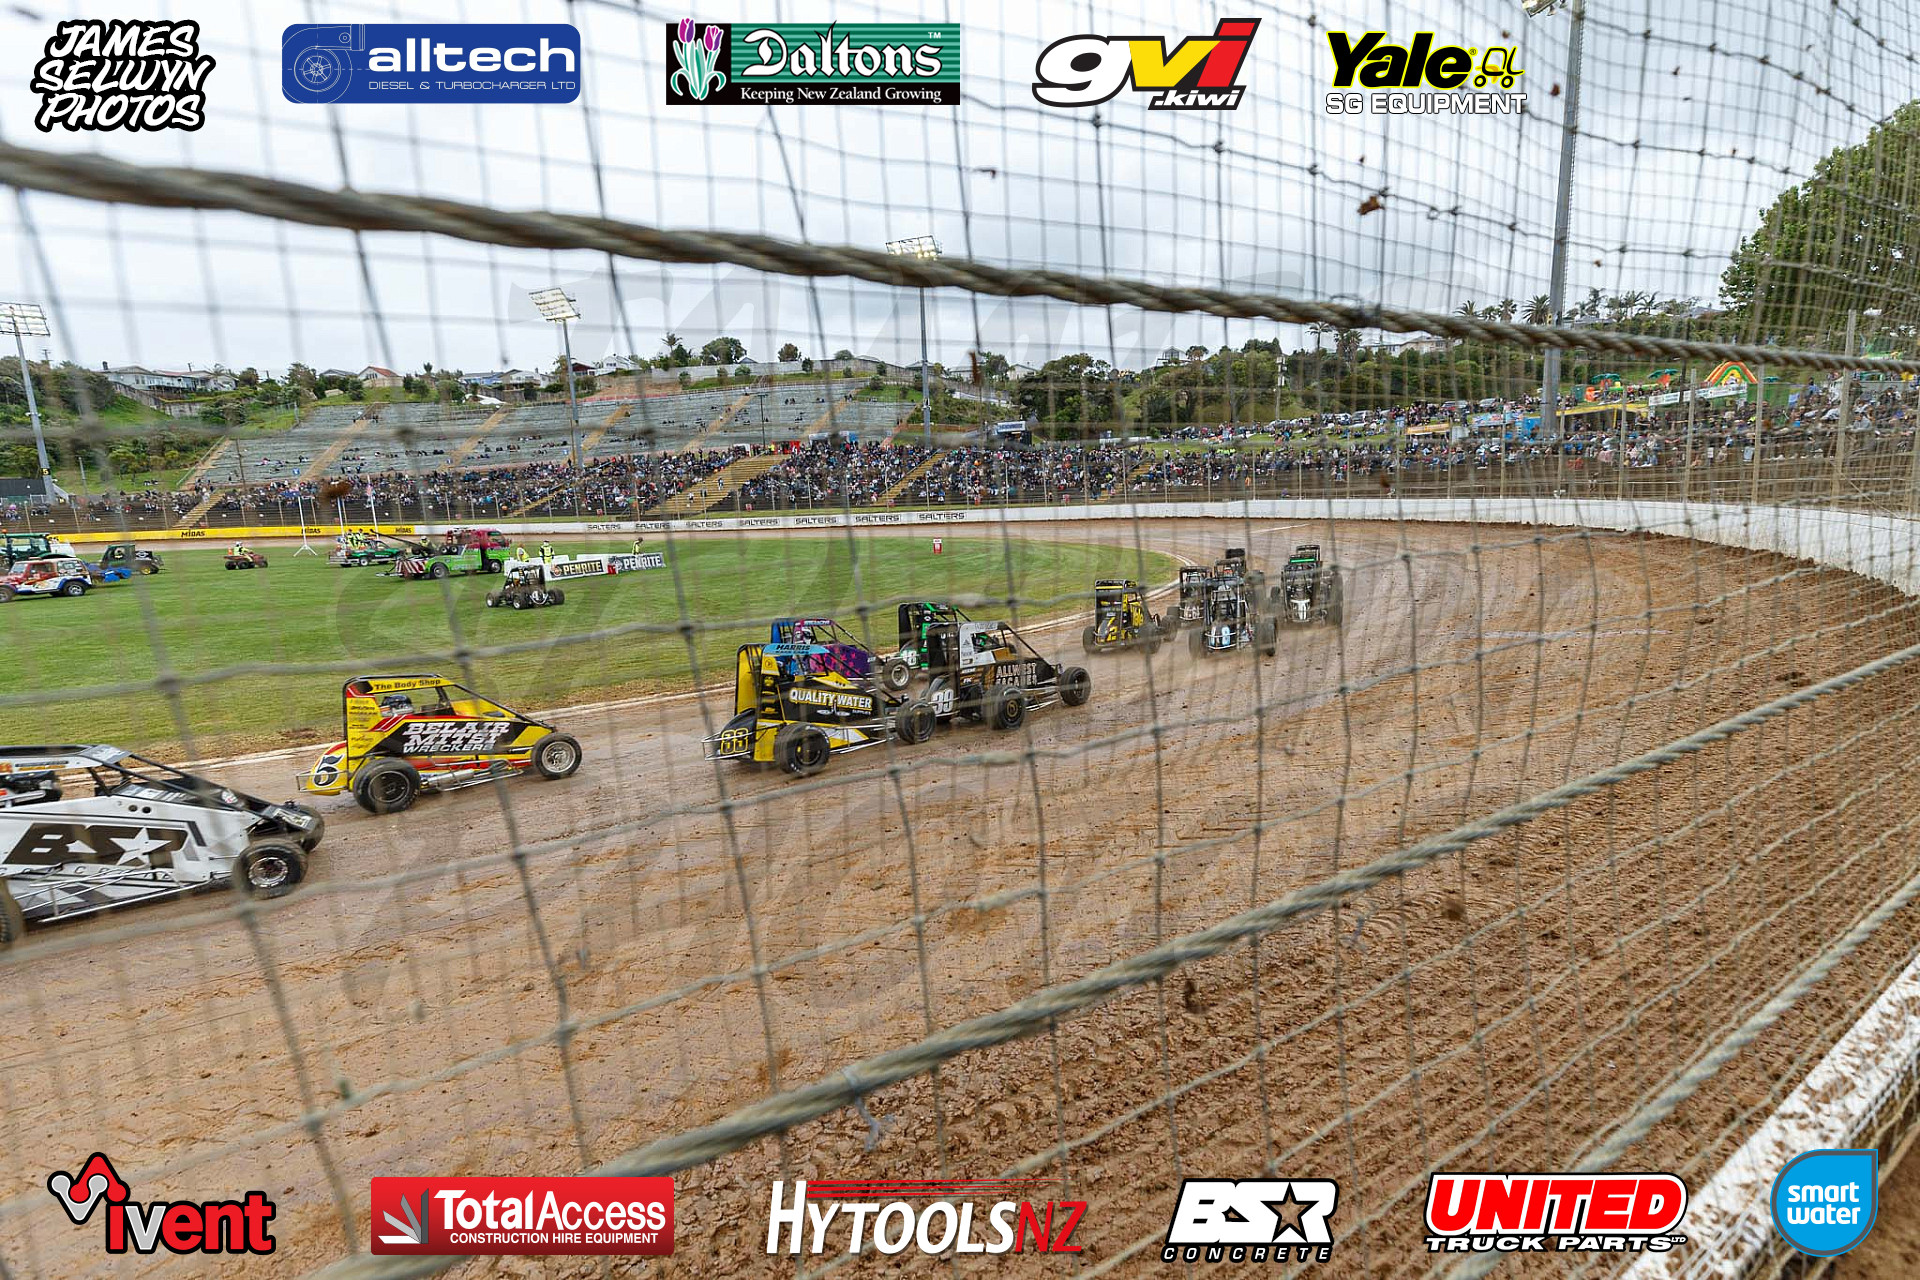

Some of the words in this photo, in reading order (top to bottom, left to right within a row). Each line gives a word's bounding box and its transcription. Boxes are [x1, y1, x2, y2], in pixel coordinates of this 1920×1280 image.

[795, 517, 837, 525] SALTERS
[855, 515, 900, 523] SALTERS
[918, 513, 965, 521] SALTERS
[181, 529, 206, 538] MIDAS
[623, 555, 661, 570] PENRITE
[563, 562, 602, 575] PENRITE
[374, 682, 392, 690] The
[394, 680, 417, 691] Body
[418, 679, 441, 688] Shop
[791, 689, 836, 704] QUALITY
[837, 694, 871, 709] WATER
[402, 743, 495, 754] WRECKERS
[313, 754, 343, 787] 5
